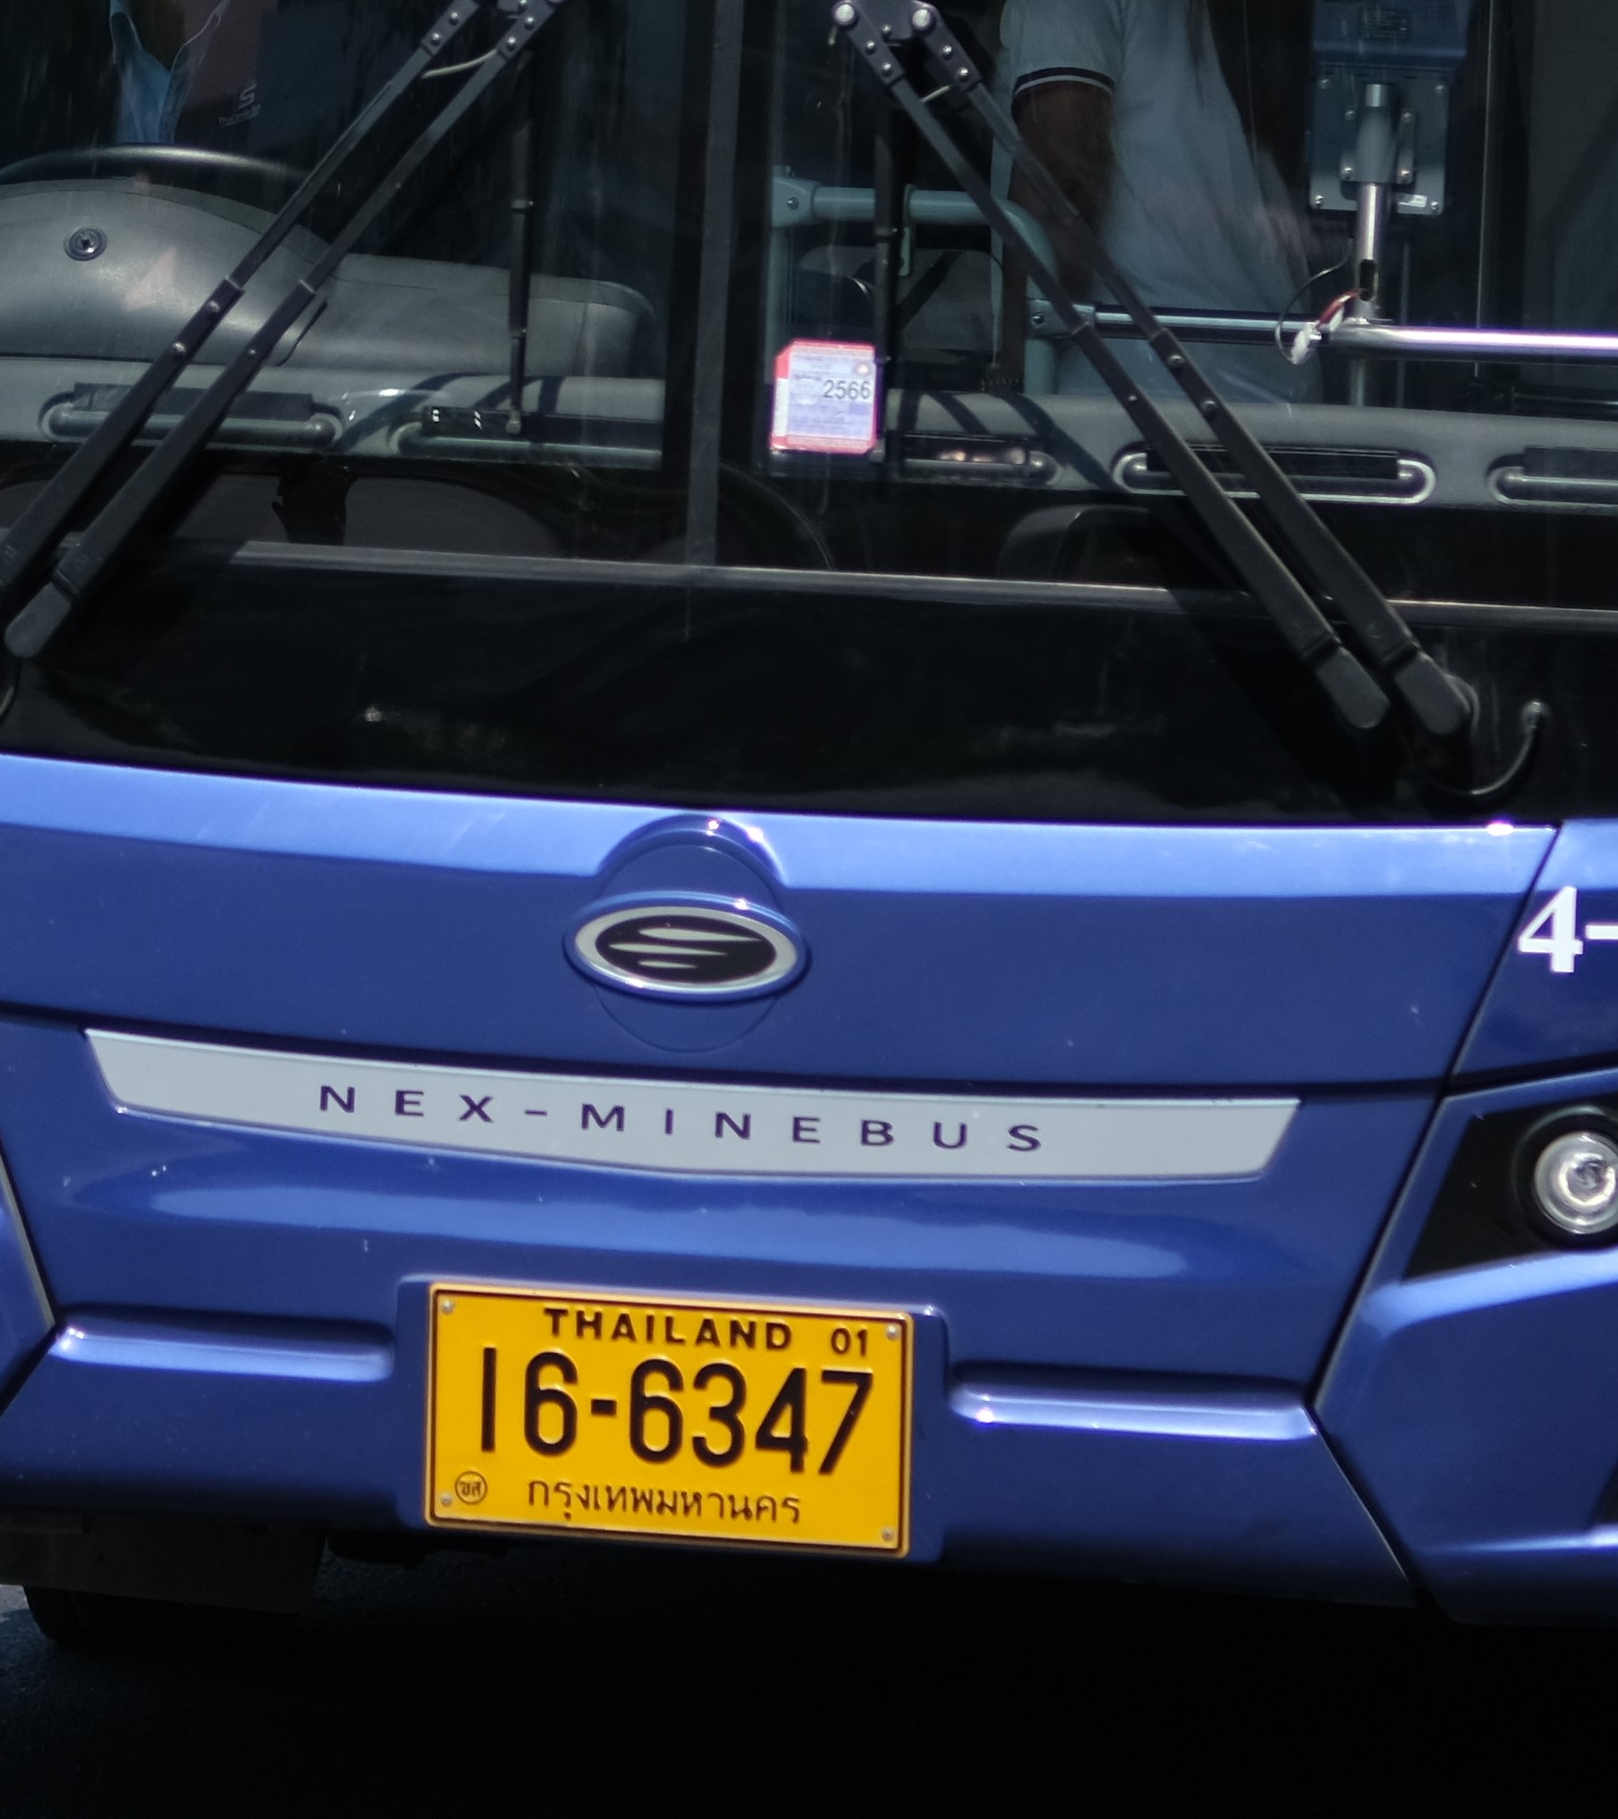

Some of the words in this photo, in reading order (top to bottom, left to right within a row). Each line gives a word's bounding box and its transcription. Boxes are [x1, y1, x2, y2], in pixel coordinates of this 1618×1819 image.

[822, 379, 872, 401] 2566
[317, 1083, 1044, 1153] NEX-MINEBUS
[543, 1307, 793, 1351] THAILAND
[830, 1327, 870, 1357] 01
[480, 1346, 874, 1475] 16-6347
[527, 1479, 801, 1525] กรุงเทพมหานคร
